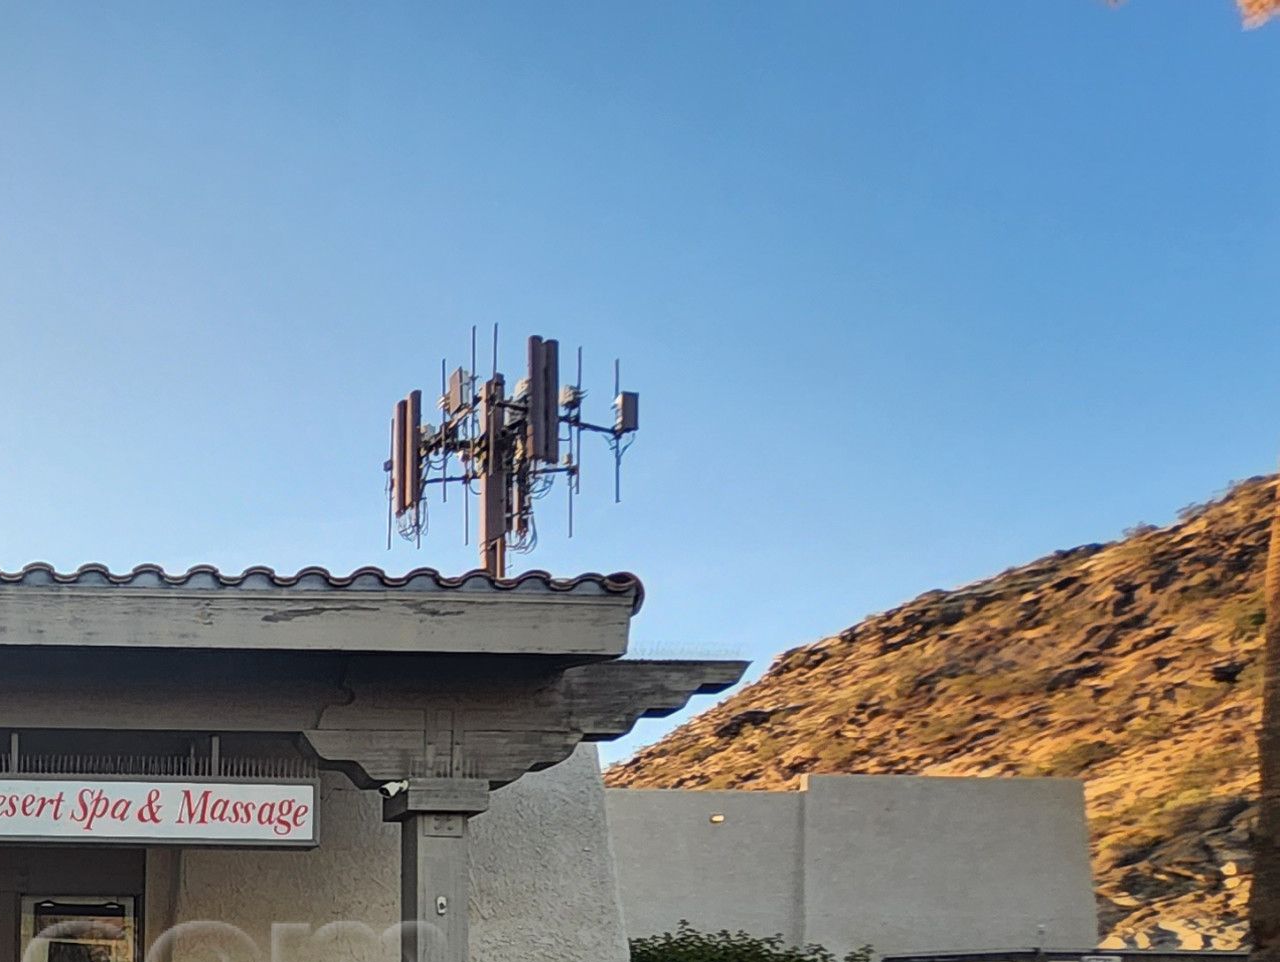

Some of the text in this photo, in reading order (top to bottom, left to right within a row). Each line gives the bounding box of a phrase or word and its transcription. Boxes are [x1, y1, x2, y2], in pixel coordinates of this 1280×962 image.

[70, 788, 130, 832] Spa
[135, 789, 163, 825] &
[176, 789, 309, 836] Massage
